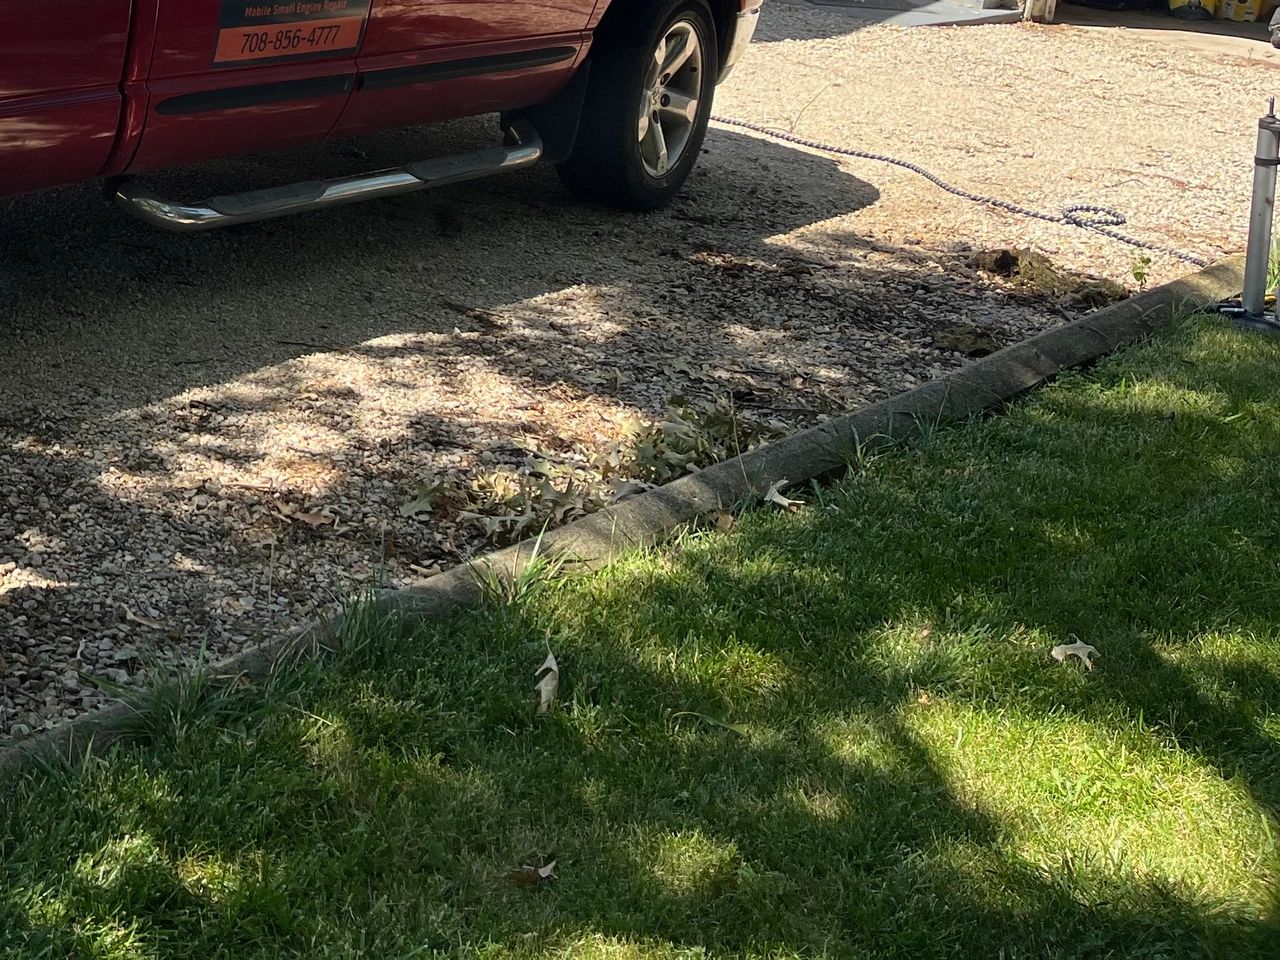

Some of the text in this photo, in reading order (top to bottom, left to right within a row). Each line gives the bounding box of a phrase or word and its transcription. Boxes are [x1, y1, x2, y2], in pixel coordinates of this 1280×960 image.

[245, 0, 348, 17] Mobile Small Engine Repair
[240, 25, 341, 54] 708-856-4777
